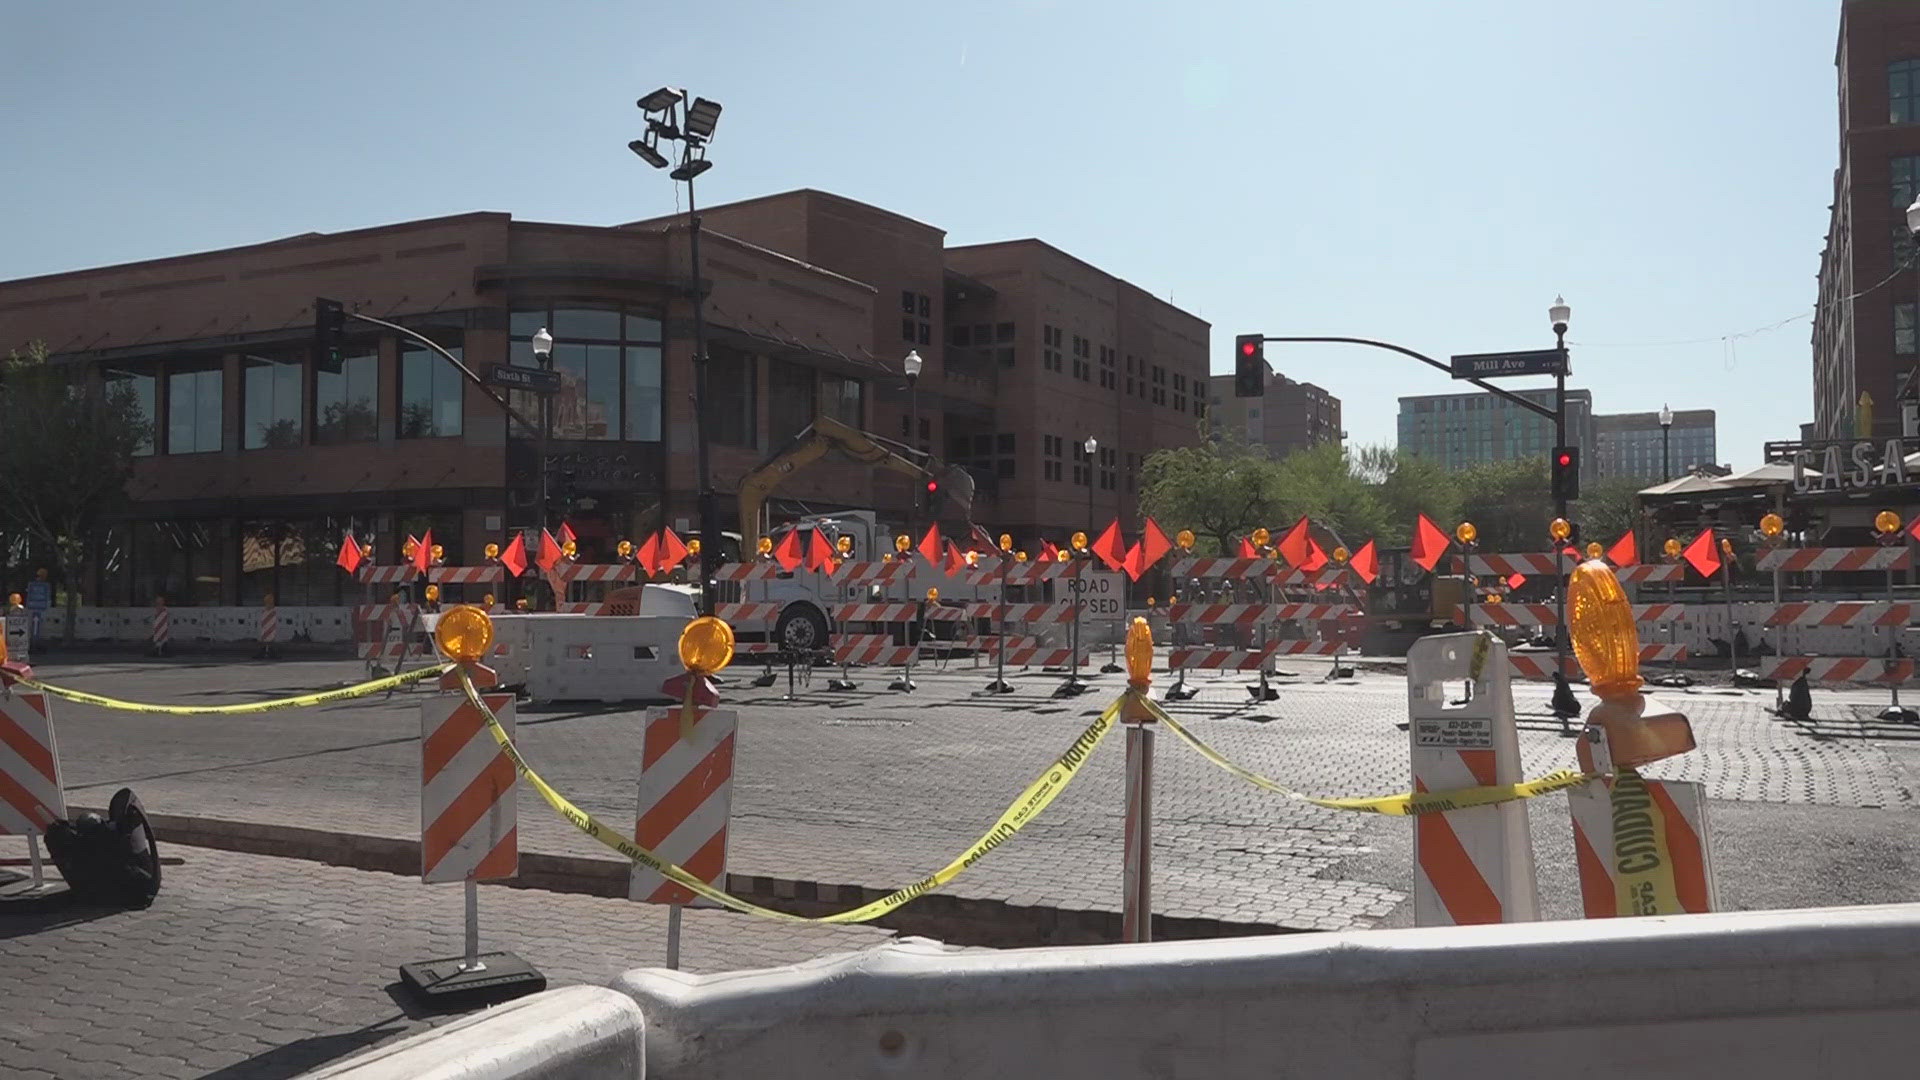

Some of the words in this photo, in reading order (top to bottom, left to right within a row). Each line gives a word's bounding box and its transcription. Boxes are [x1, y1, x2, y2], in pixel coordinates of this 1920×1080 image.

[1473, 361, 1498, 371] Mill
[1502, 360, 1525, 369] Ave
[497, 369, 520, 381] Sixth
[522, 373, 531, 383] St
[1068, 579, 1109, 593] ROAD
